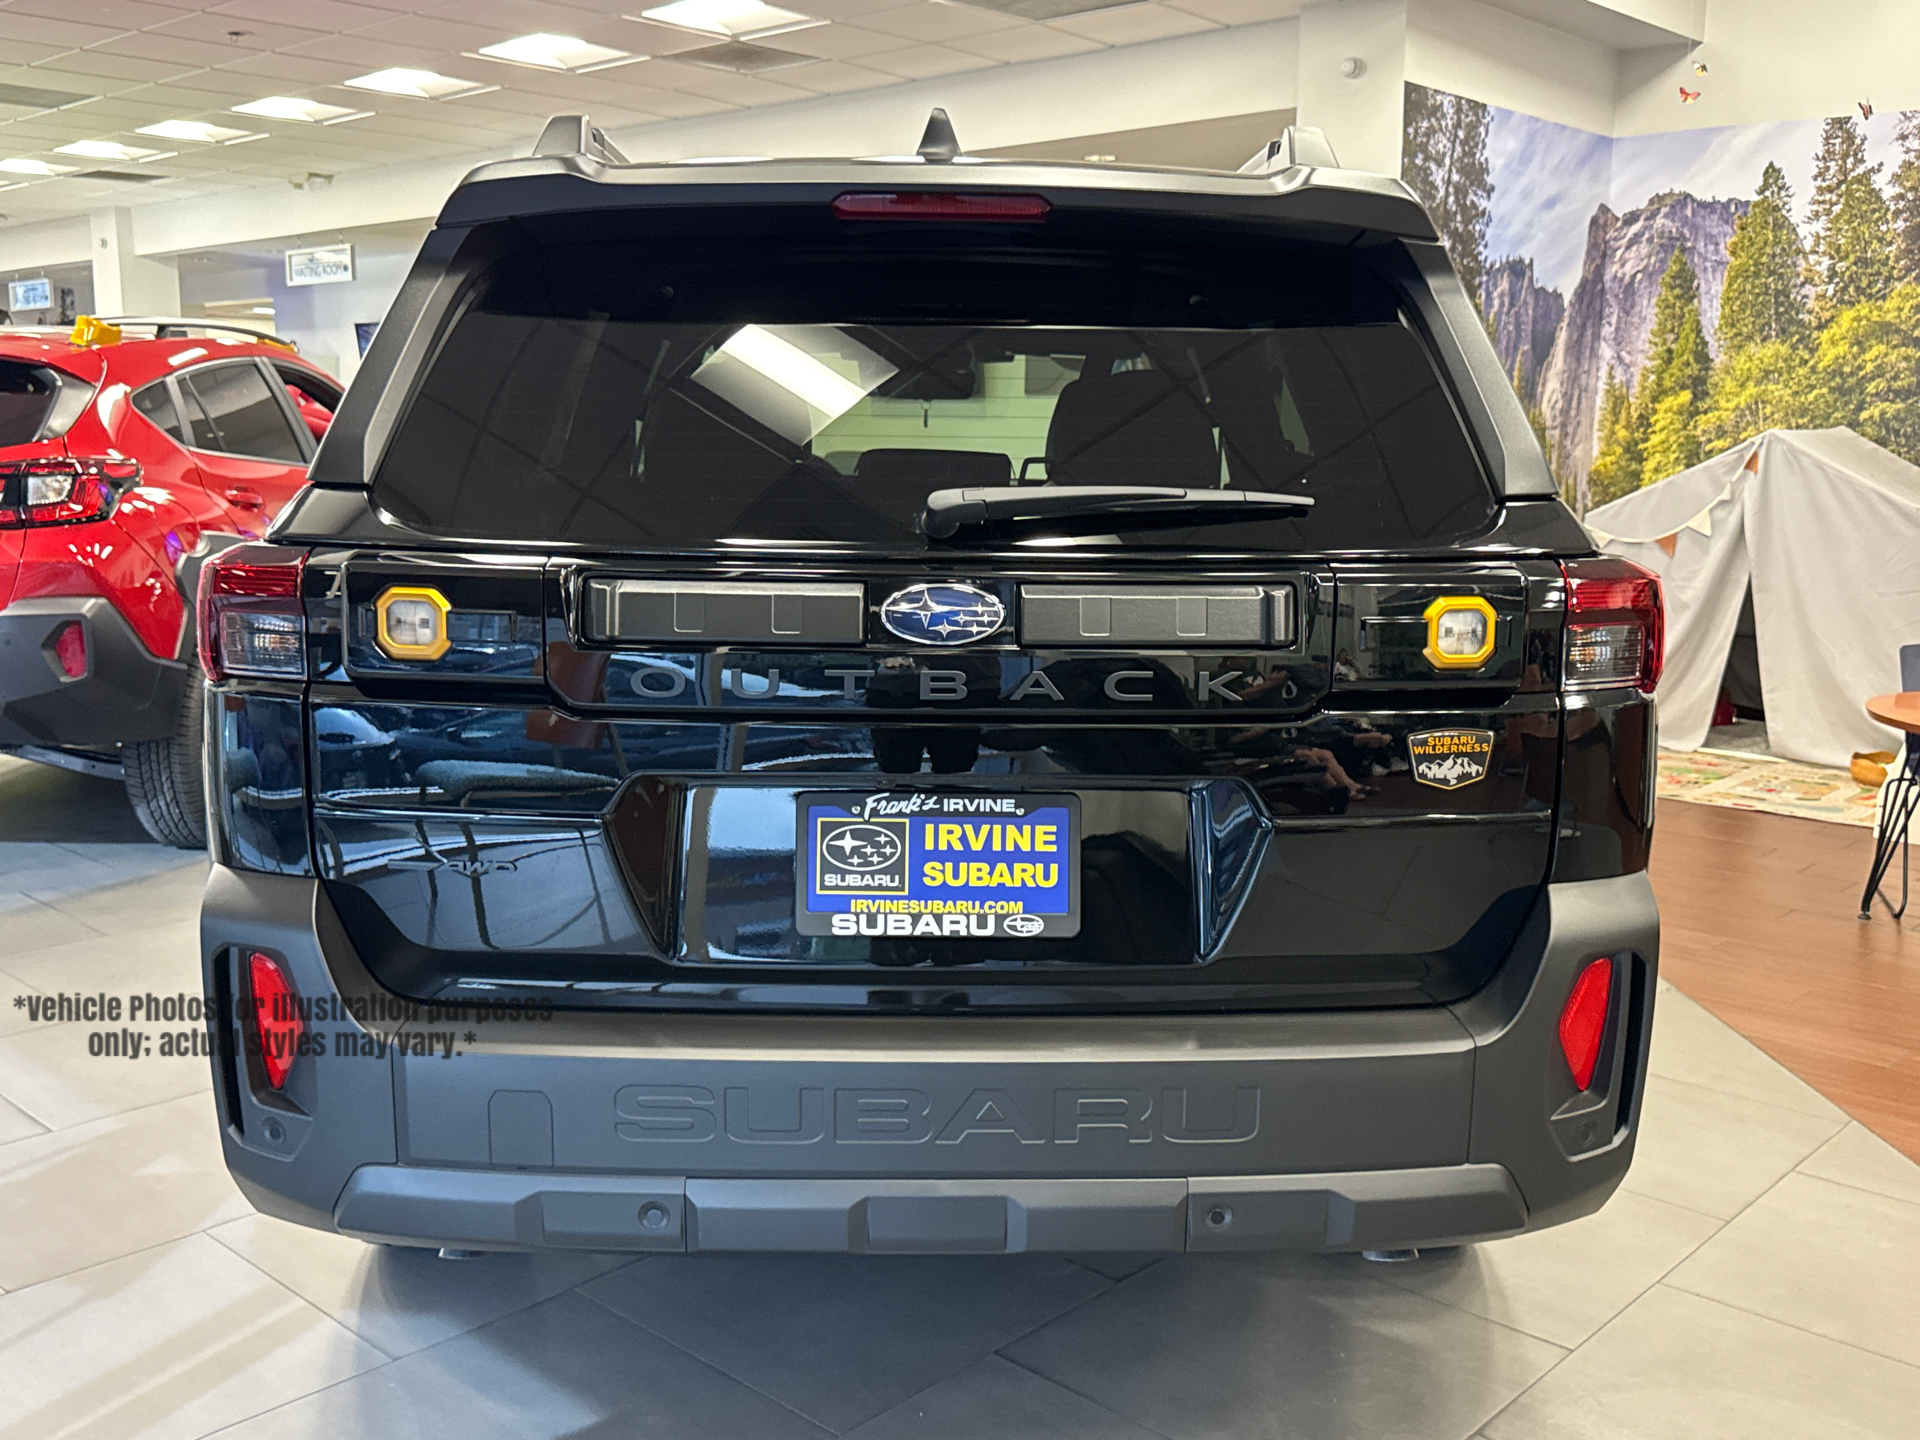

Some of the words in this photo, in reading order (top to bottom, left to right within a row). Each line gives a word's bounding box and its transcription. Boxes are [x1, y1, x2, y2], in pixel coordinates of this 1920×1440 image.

[630, 668, 1243, 701] OUTBACK
[1413, 743, 1489, 754] WILDERNESS
[1427, 736, 1476, 746] SUBARU
[863, 792, 940, 820] Frank's
[943, 798, 1016, 813] IRVINE
[924, 823, 1058, 852] IRVINE
[824, 873, 900, 887] SUBARU
[923, 861, 1059, 888] SUBARU
[850, 898, 1024, 914] IRVINESUBARU.COM
[831, 913, 996, 936] SUBARU
[613, 1083, 1262, 1145] SUBARU
